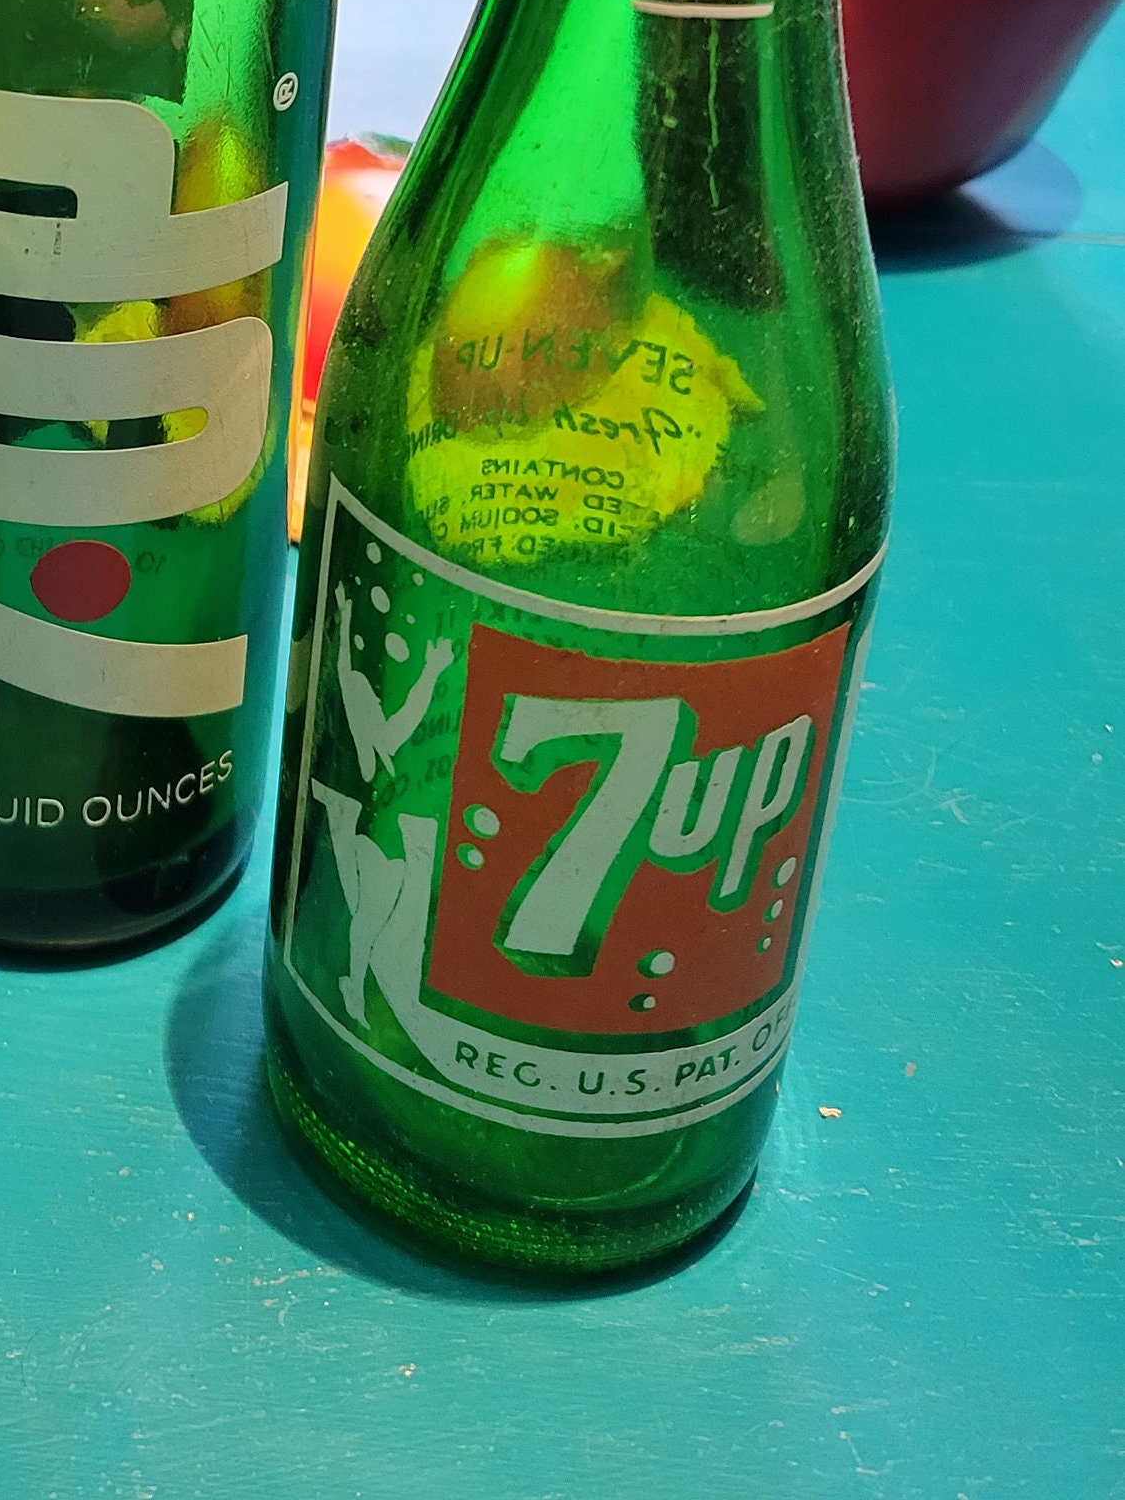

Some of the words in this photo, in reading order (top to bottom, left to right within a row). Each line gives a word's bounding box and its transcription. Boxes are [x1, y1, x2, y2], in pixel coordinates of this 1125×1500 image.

[81, 749, 234, 829] OUNCES
[577, 1067, 661, 1097] U.S.
[674, 1044, 742, 1087] PAT.
